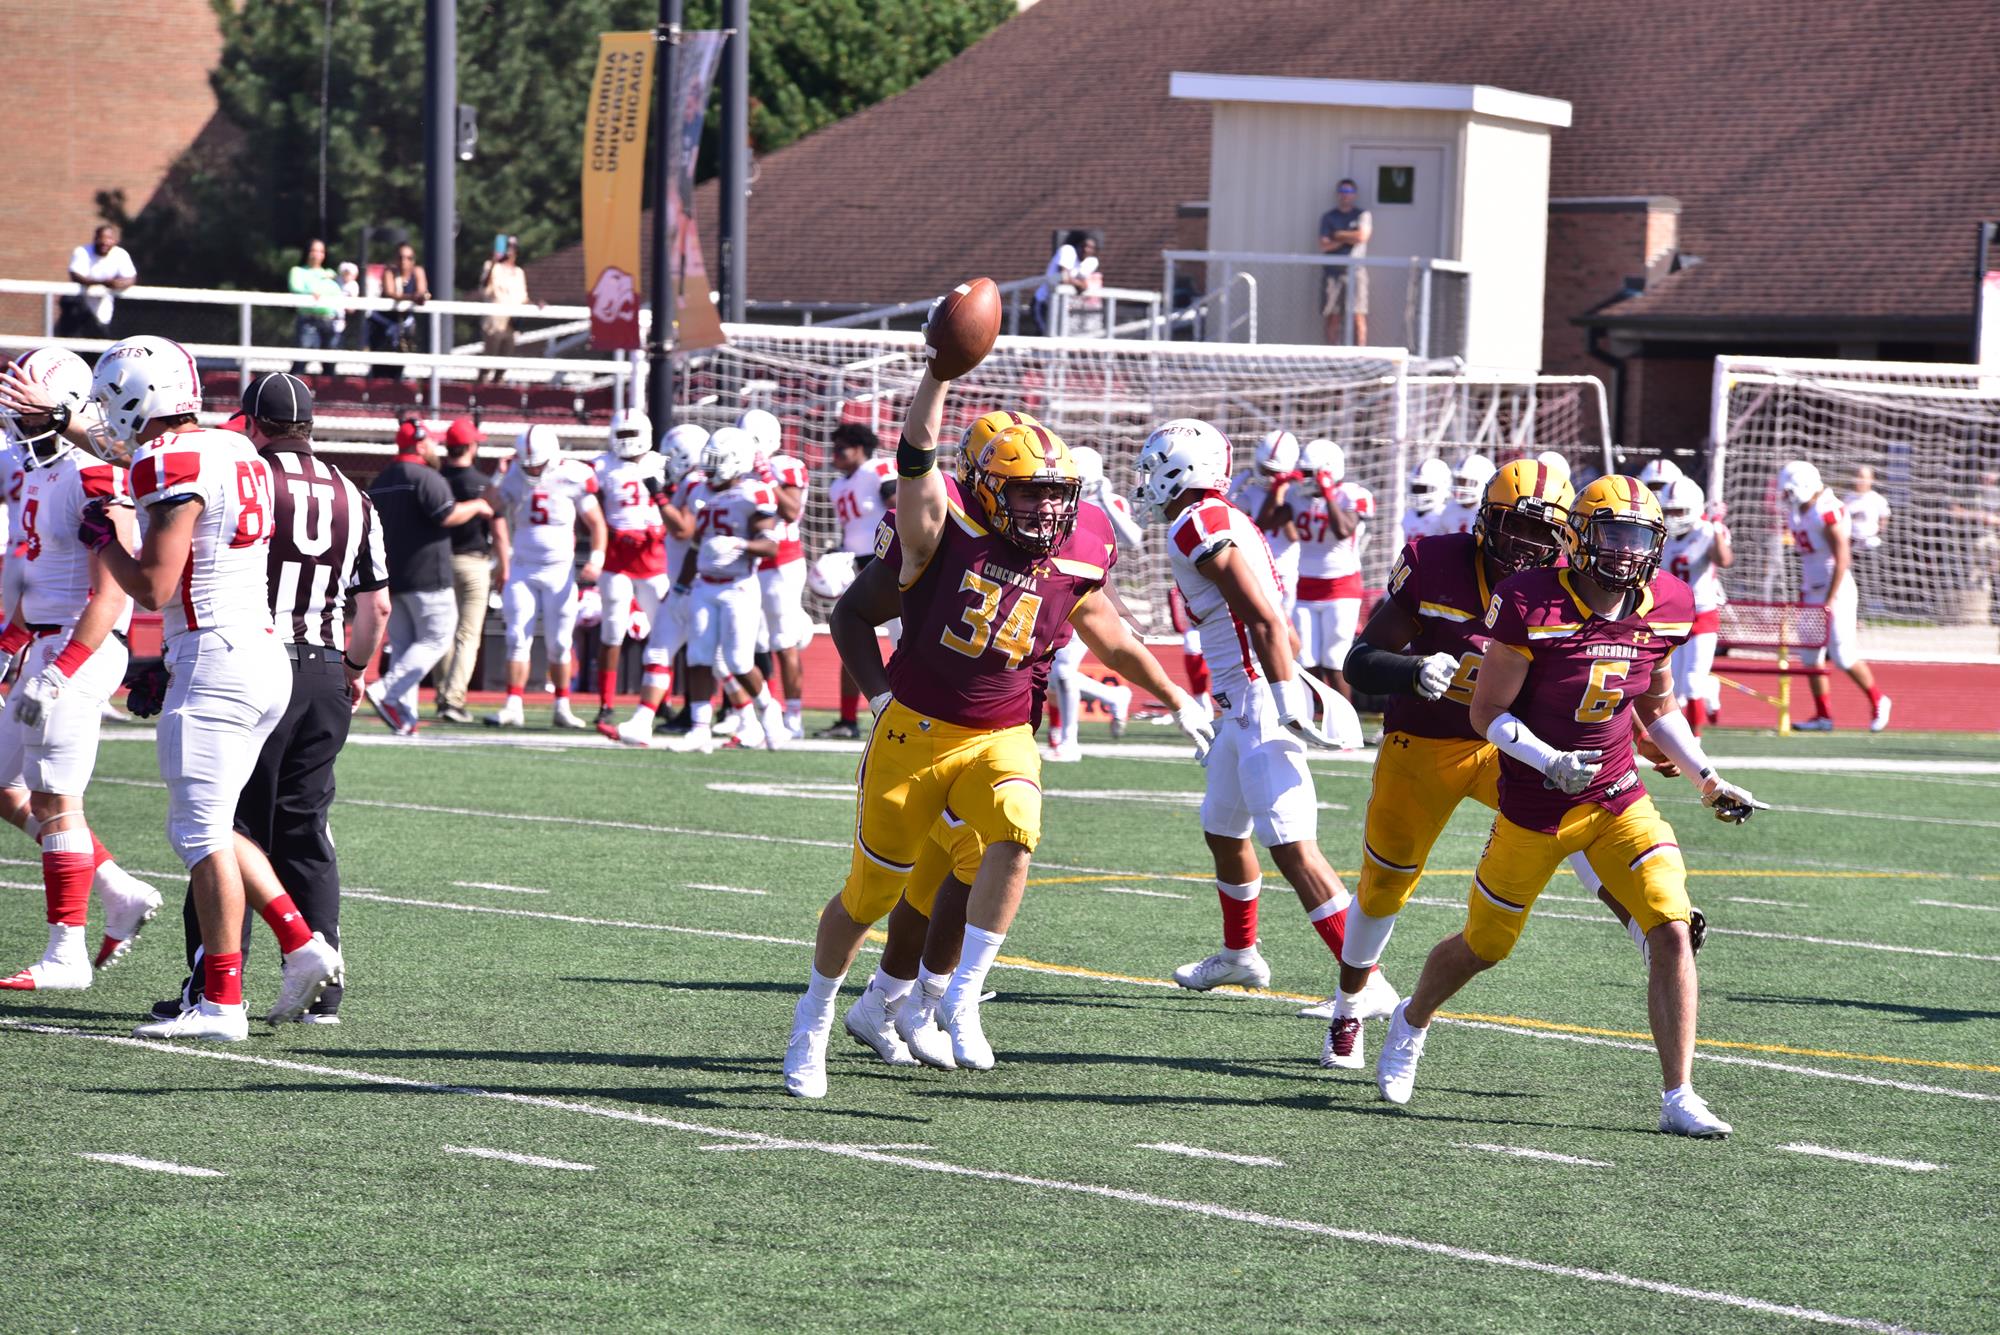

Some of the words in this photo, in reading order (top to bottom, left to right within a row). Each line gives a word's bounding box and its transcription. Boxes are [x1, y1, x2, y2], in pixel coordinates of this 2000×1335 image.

[592, 52, 617, 171] CONCORDIA
[606, 52, 630, 173] UNIVERSITY
[624, 51, 645, 142] CHICAGO
[982, 444, 996, 465] C
[228, 460, 277, 549] 87
[288, 483, 335, 556] U
[530, 493, 549, 525] 5
[874, 520, 895, 560] 79
[940, 568, 1043, 670] 34
[1485, 594, 1503, 629] 6
[1575, 659, 1631, 723] 6
